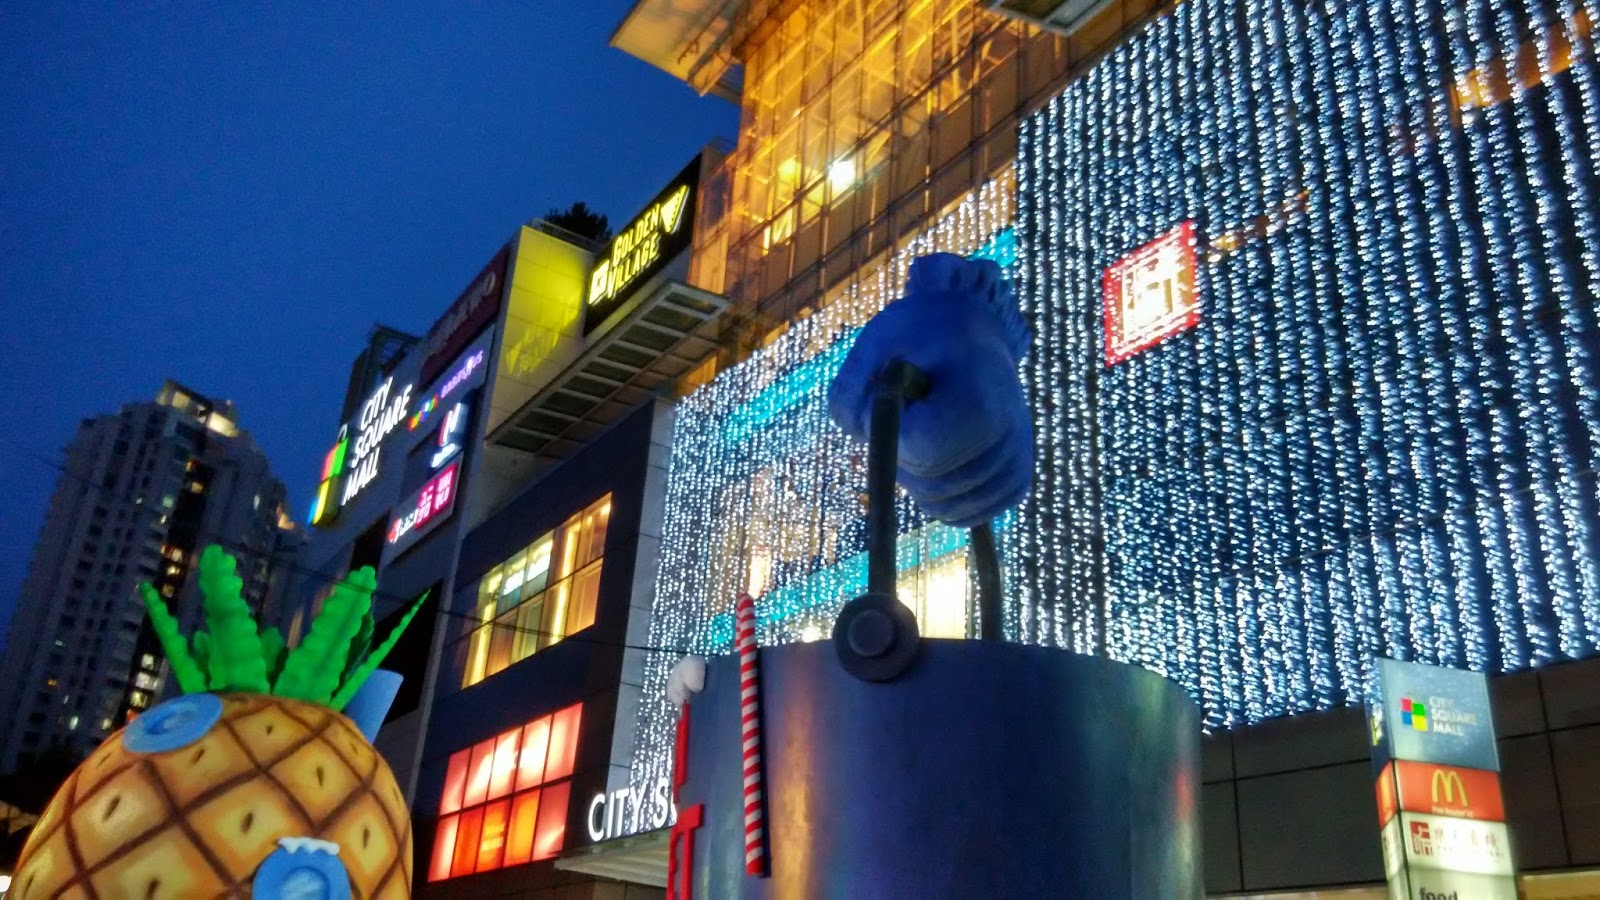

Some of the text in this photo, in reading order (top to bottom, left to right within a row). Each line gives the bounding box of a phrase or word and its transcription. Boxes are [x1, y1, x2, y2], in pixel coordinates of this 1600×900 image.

[612, 203, 661, 268] GOLDEN
[607, 232, 660, 299] VILLAGE
[349, 384, 413, 468] SQUARE
[361, 376, 394, 431] CITY
[341, 447, 380, 506] MALL
[1429, 696, 1455, 709] CITY
[1431, 707, 1478, 726] SQUARE
[1433, 721, 1464, 736] MALL
[588, 780, 648, 841] CITY
